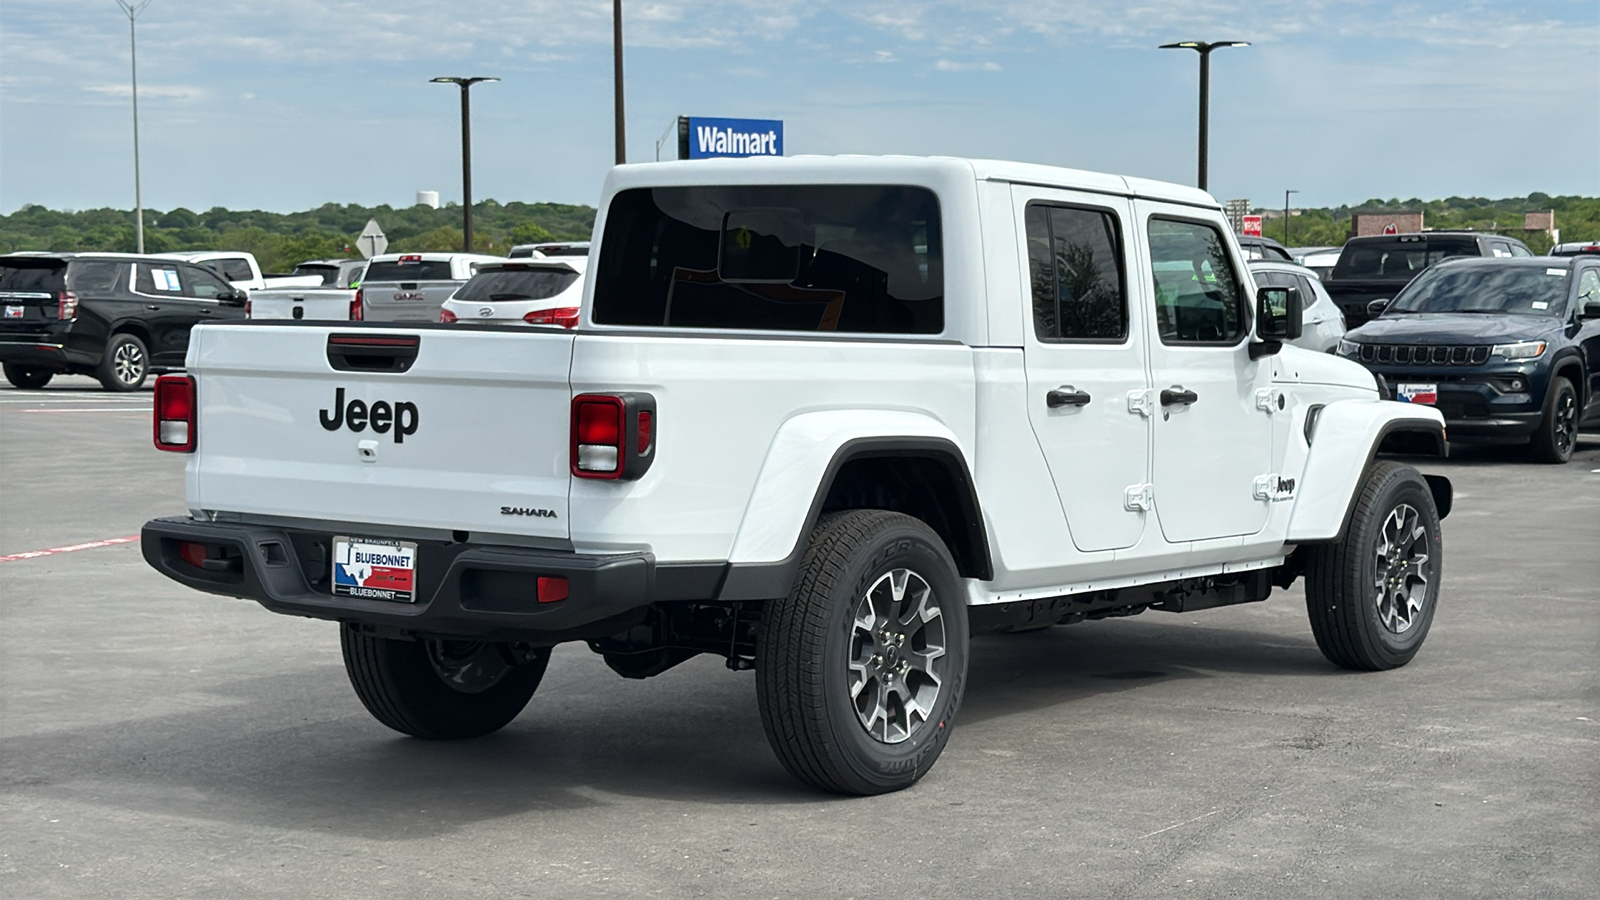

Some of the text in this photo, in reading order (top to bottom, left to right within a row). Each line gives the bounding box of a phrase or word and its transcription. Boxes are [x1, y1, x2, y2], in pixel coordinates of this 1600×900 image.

[697, 126, 777, 155] Walmart
[393, 292, 425, 301] GMC
[319, 387, 419, 444] Jeep
[1274, 476, 1296, 495] Jeep
[500, 506, 558, 518] SAHARA
[355, 551, 411, 567] BLUEBONNET
[350, 586, 396, 599] BLUEBONNET
